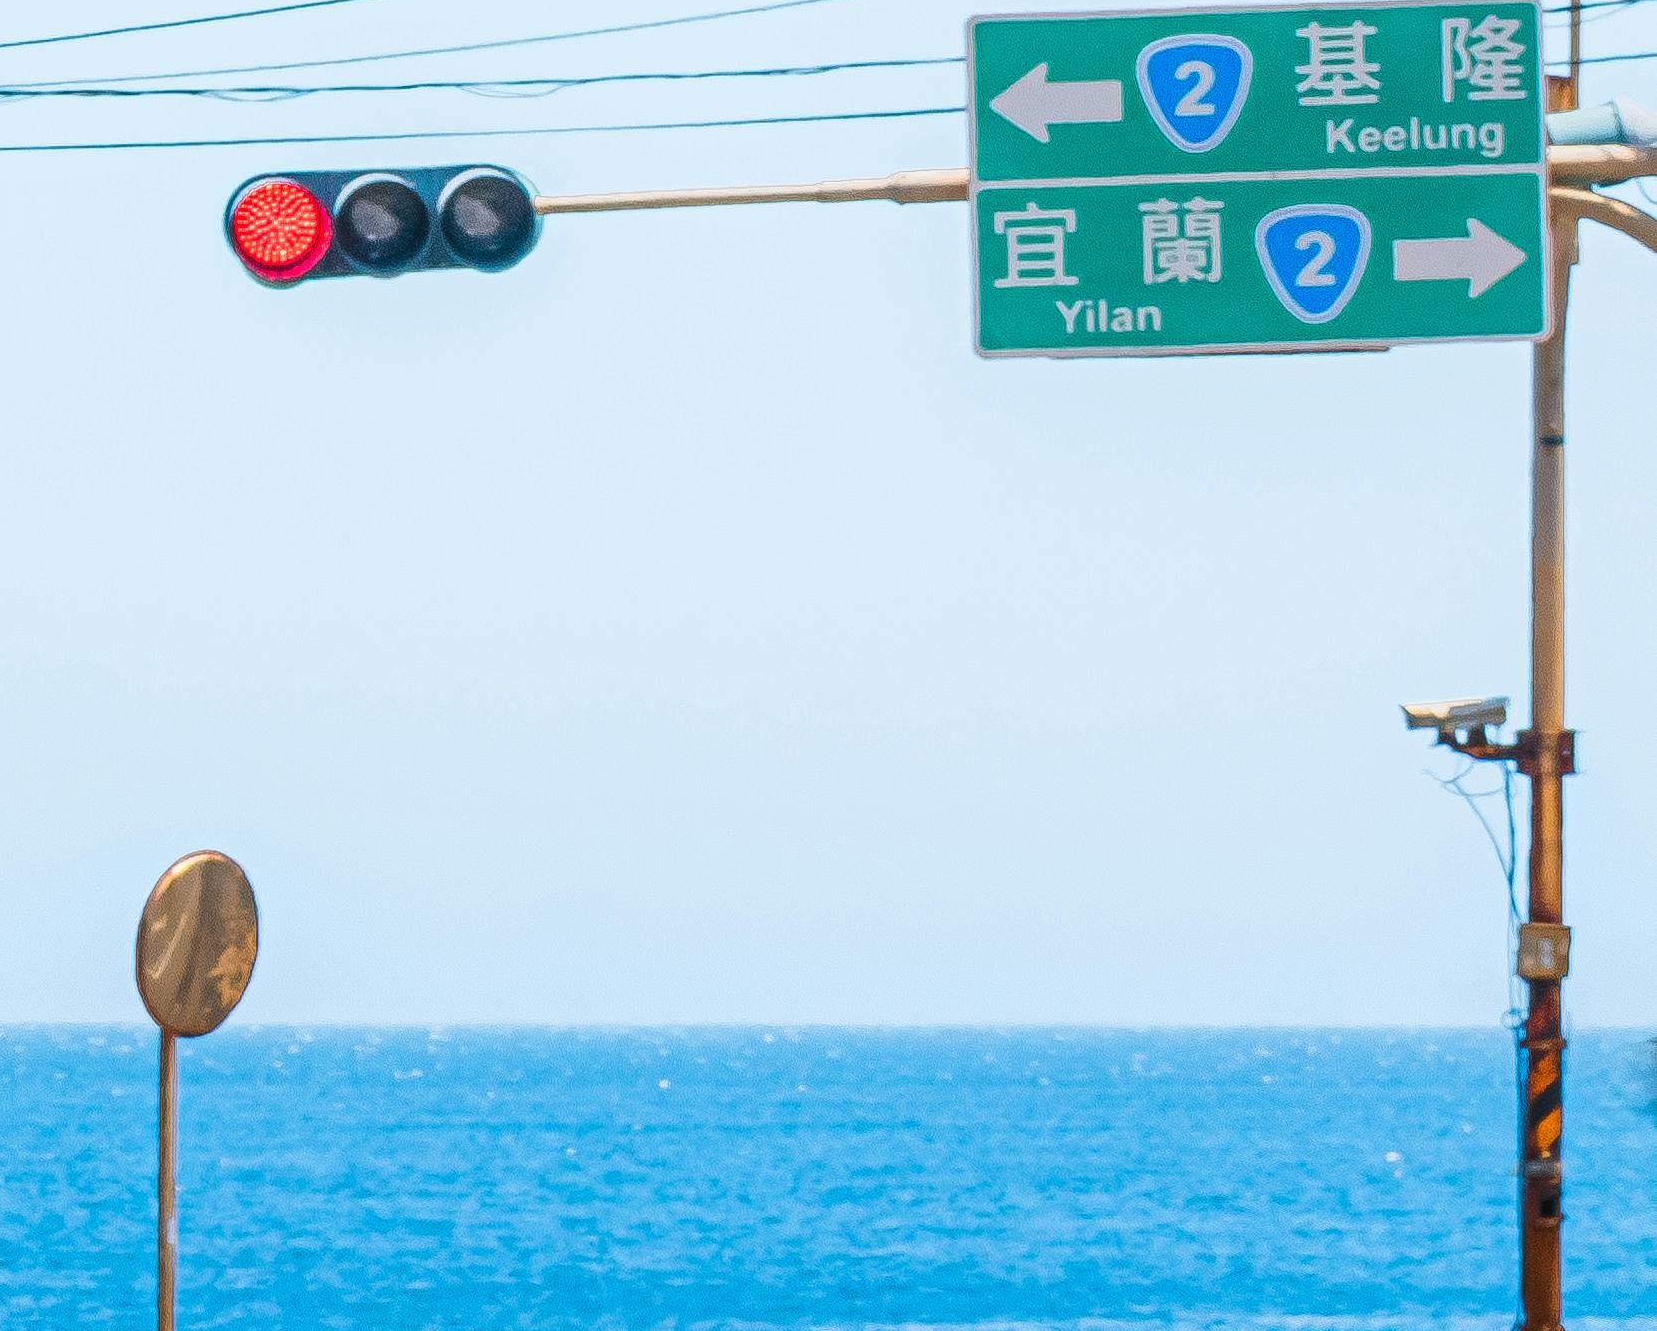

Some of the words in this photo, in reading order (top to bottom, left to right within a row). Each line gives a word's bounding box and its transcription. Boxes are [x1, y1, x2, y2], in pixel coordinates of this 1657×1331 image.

[1174, 60, 1216, 117] 2
[1295, 14, 1528, 107] 基隆
[1325, 117, 1505, 158] Keelung
[993, 196, 1227, 289] 宜蘭
[1294, 230, 1336, 287] 2
[1055, 299, 1162, 334] Yilan
